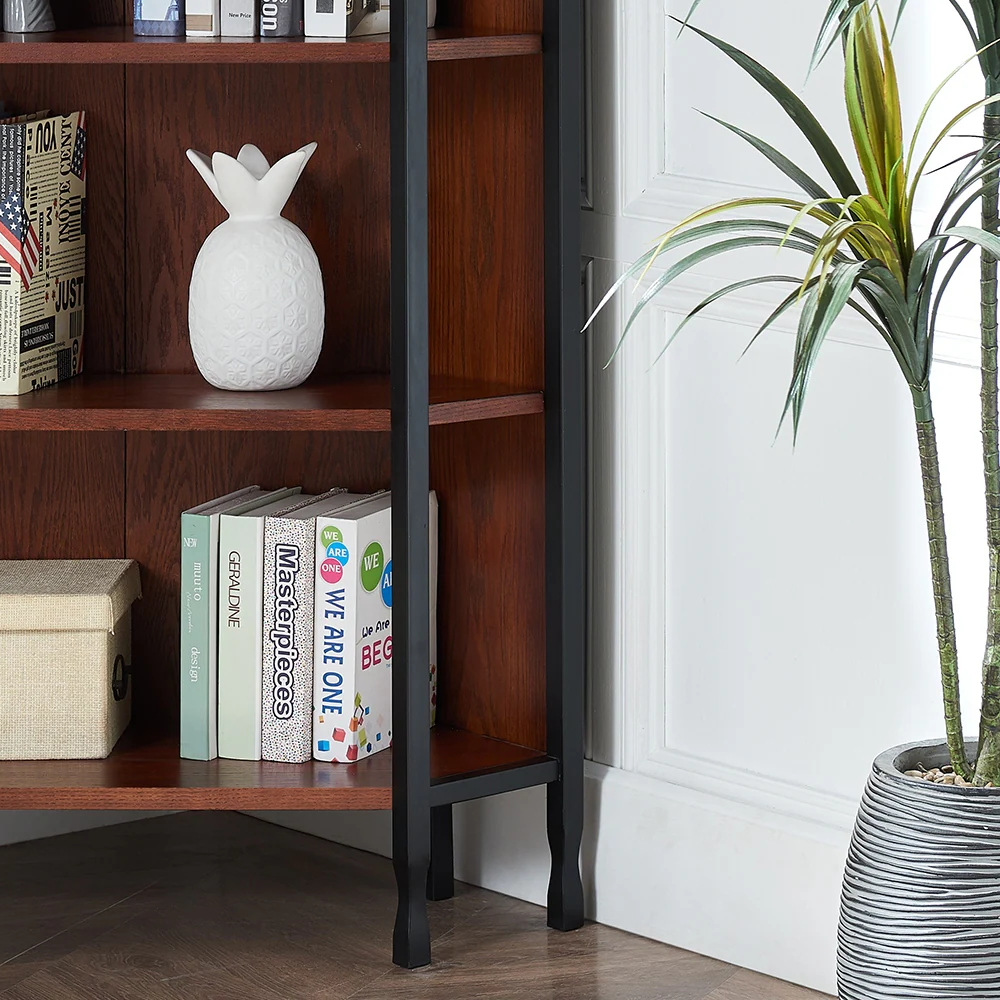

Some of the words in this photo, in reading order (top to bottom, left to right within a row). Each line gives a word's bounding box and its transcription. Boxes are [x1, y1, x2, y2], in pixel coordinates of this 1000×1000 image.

[35, 120, 57, 154] YOU
[323, 531, 339, 540] WE
[322, 564, 342, 573] ONE
[328, 548, 347, 558] ARE
[363, 552, 380, 572] WE
[193, 562, 202, 601] muuto
[228, 550, 240, 628] GERALDINE
[324, 588, 345, 620] WE
[270, 545, 299, 718] Masterpieces
[324, 625, 344, 665] ARE
[362, 627, 374, 638] We
[375, 620, 390, 633] Are
[189, 646, 200, 682] design
[322, 672, 344, 715] ONE
